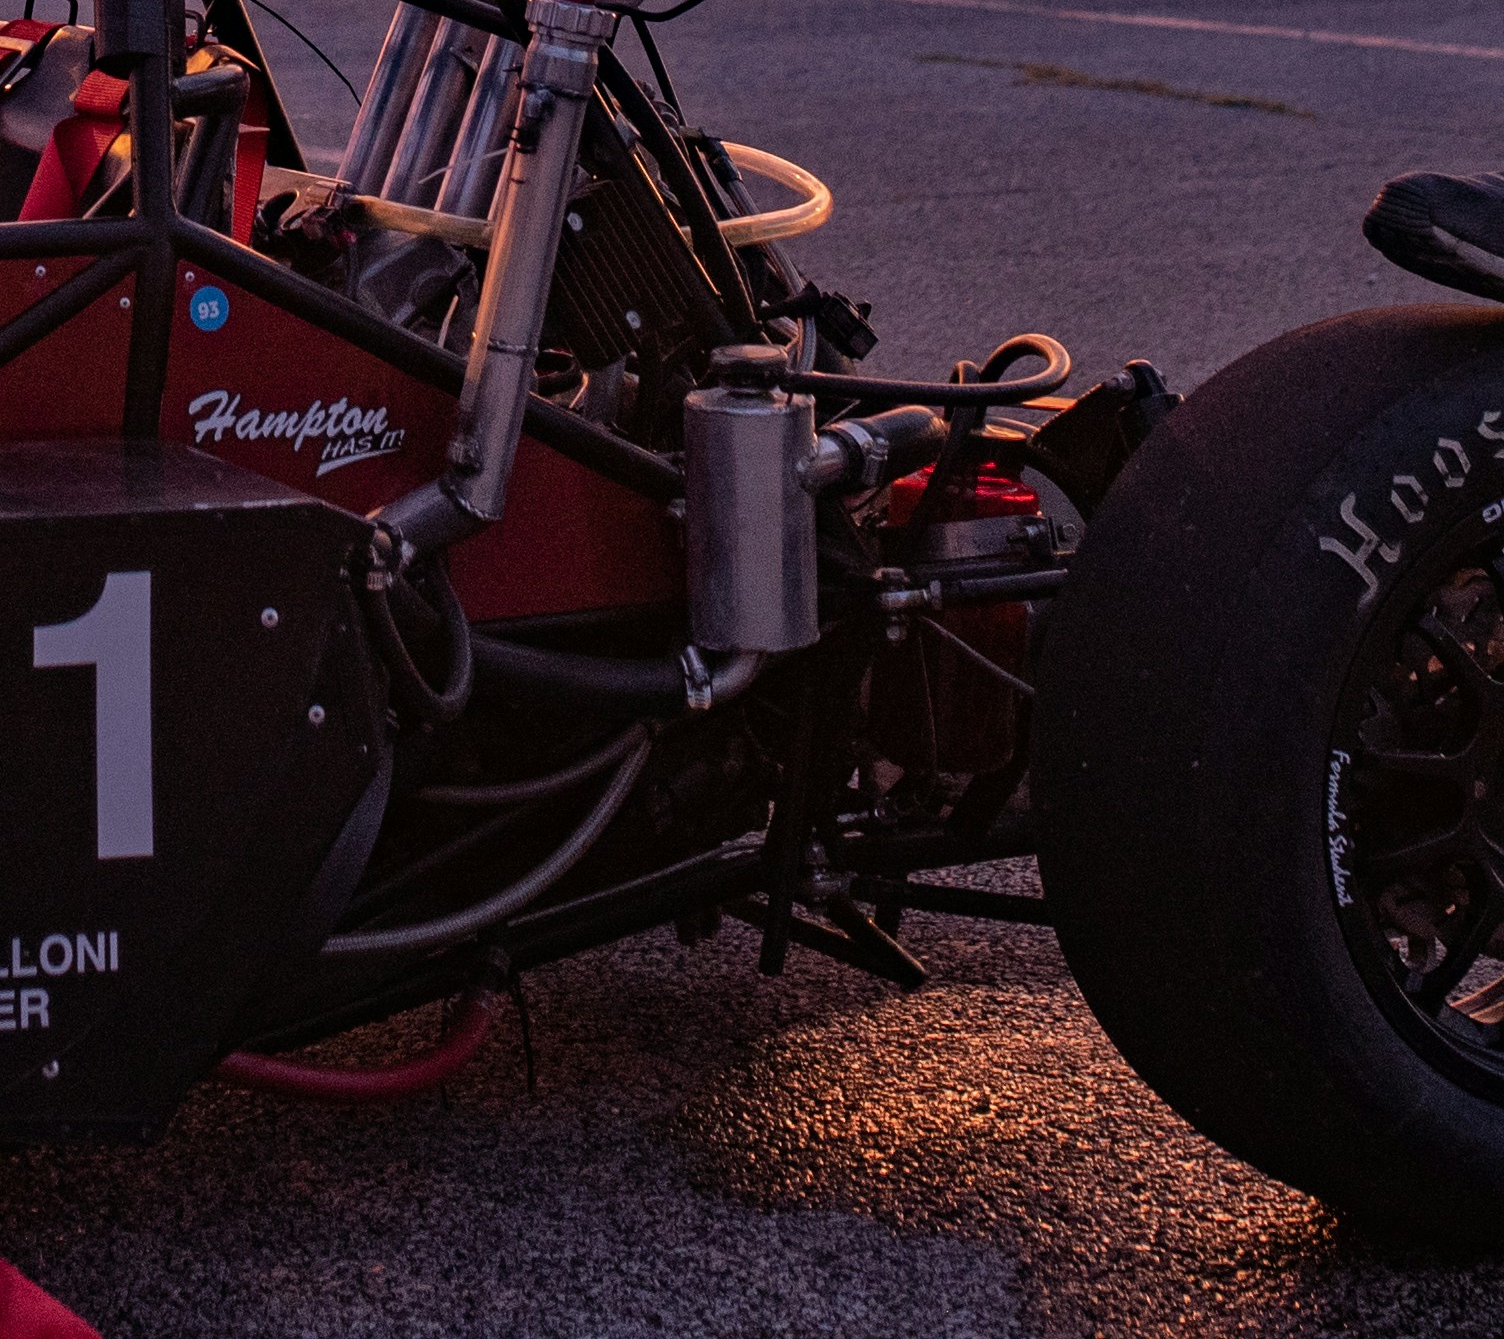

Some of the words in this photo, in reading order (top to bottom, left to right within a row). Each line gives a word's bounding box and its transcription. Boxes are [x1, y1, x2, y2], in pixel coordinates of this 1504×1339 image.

[196, 299, 222, 322] 93
[187, 388, 390, 454] Hampton
[321, 435, 374, 461] HAS
[379, 427, 406, 450] IT!
